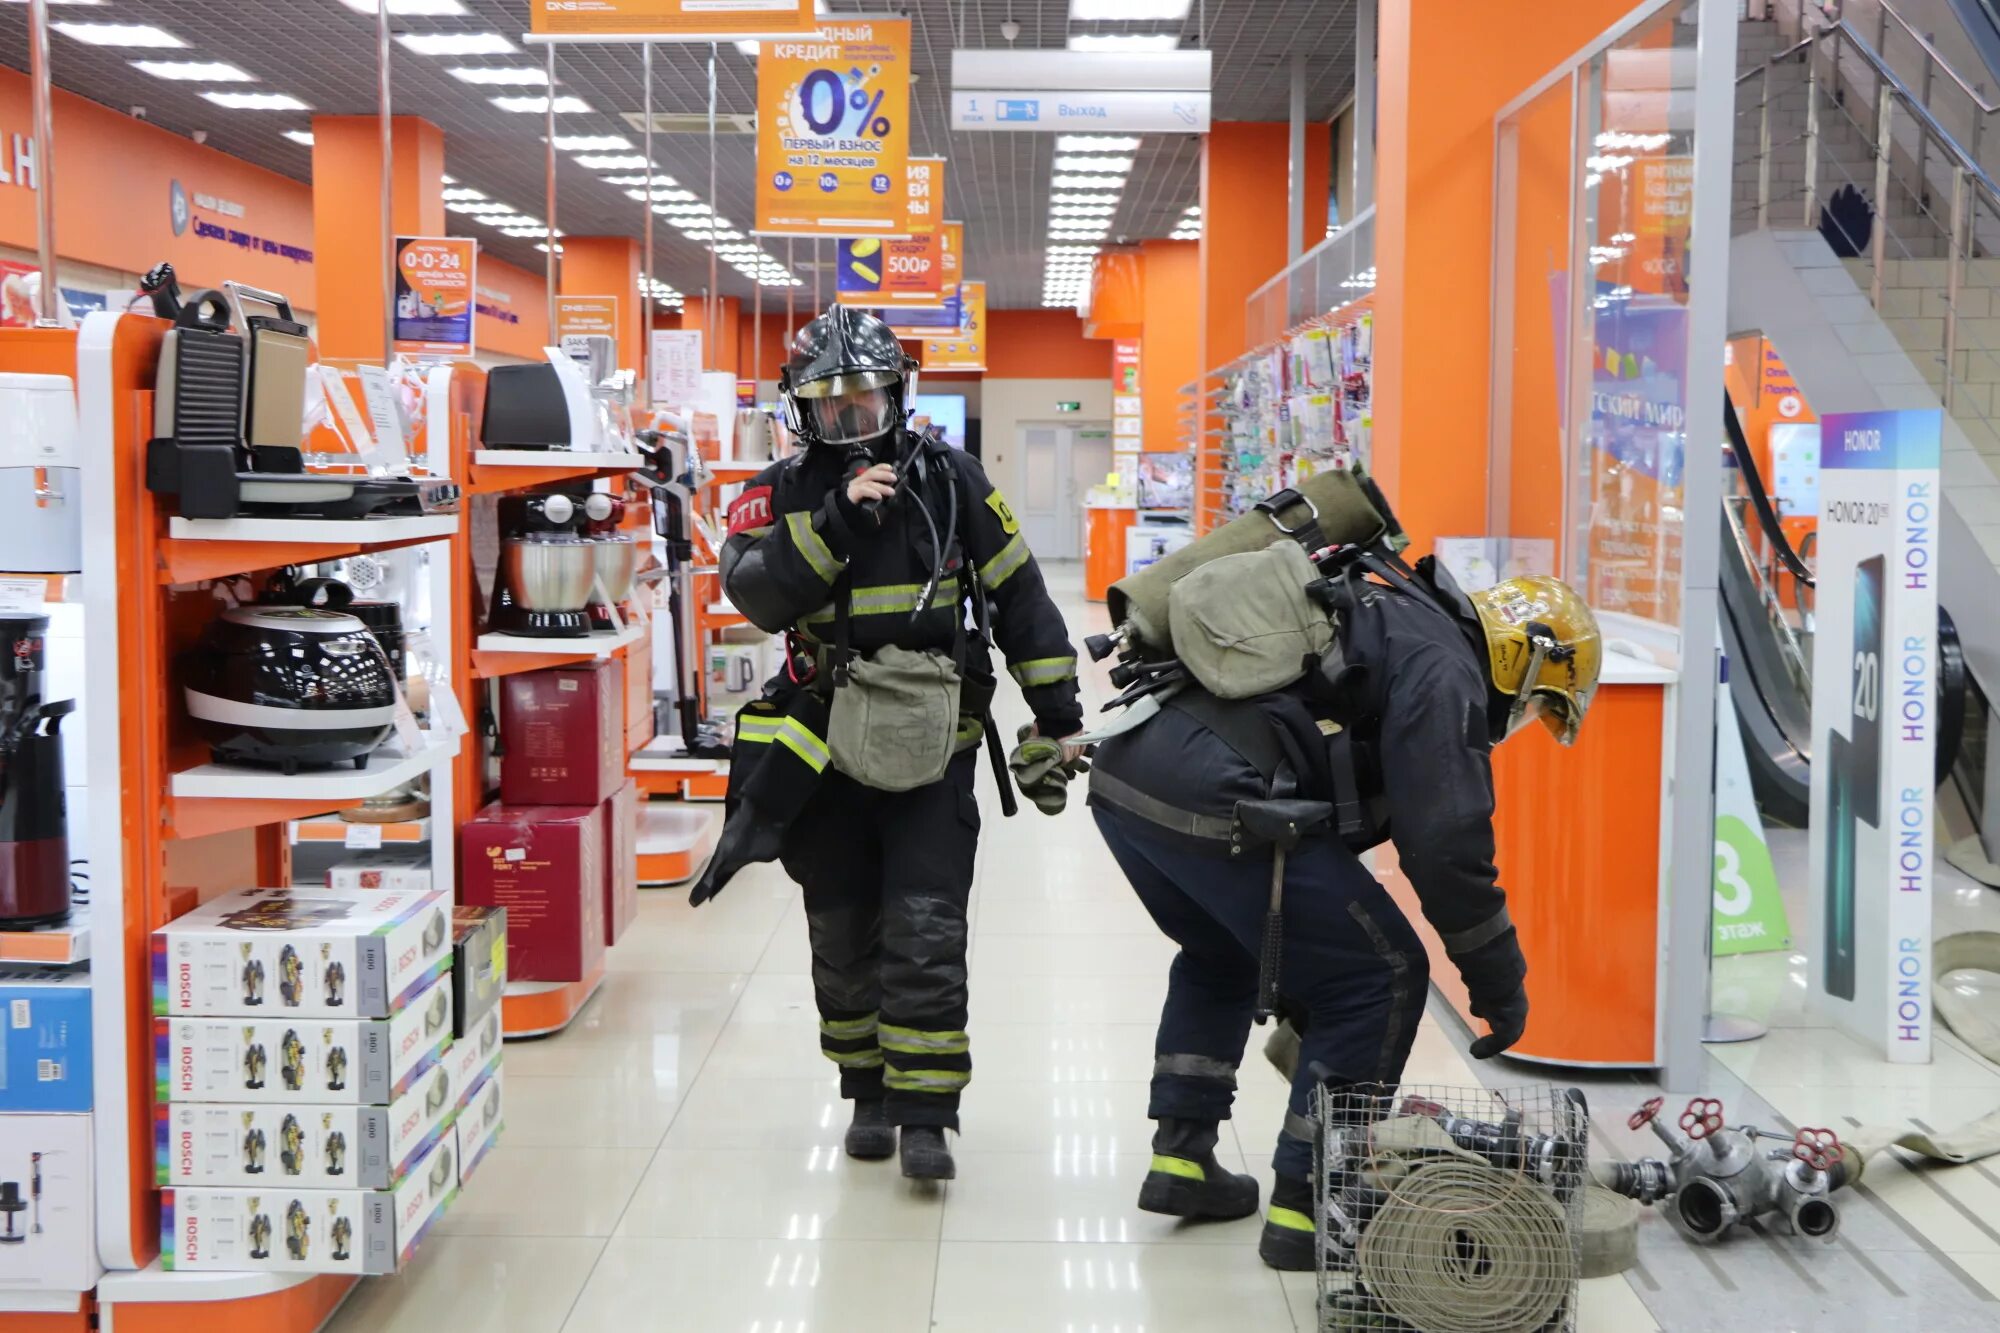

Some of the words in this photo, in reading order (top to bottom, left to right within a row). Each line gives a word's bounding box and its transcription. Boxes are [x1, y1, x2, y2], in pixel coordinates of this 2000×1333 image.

[816, 24, 873, 42] ДНЫЙ
[774, 44, 840, 60] КРЕДИТ
[800, 68, 891, 138] 0%
[969, 99, 978, 112] 1
[1058, 103, 1108, 118] Выход
[783, 137, 835, 151] ПЕРВЫЙ
[839, 139, 882, 152] ВЗНОС
[788, 155, 803, 164] на
[807, 154, 819, 165] 12
[823, 156, 875, 167] месяцев
[874, 176, 887, 187] 12
[405, 252, 460, 269] 0-0-24
[887, 256, 932, 273] 500₽
[1844, 430, 1881, 451] HONOR
[731, 496, 768, 529] РТП
[1827, 500, 1865, 524] HONOR
[1866, 503, 1880, 525] 20
[1905, 481, 1931, 589] HONOR
[1853, 650, 1878, 722] 20
[1902, 635, 1926, 742] HONOR
[1899, 787, 1924, 892] HONOR
[1713, 840, 1752, 916] 3
[1718, 922, 1767, 941] этаж
[367, 948, 375, 971] 1800
[180, 963, 191, 1008] BOSCH
[1897, 937, 1922, 1042] HONOR
[369, 1032, 377, 1054] 1800
[181, 1047, 192, 1091] BOSCH
[368, 1117, 376, 1139] 1800
[181, 1131, 192, 1176] BOSCH
[374, 1202, 382, 1225] 1800
[187, 1216, 198, 1261] BOSCH
